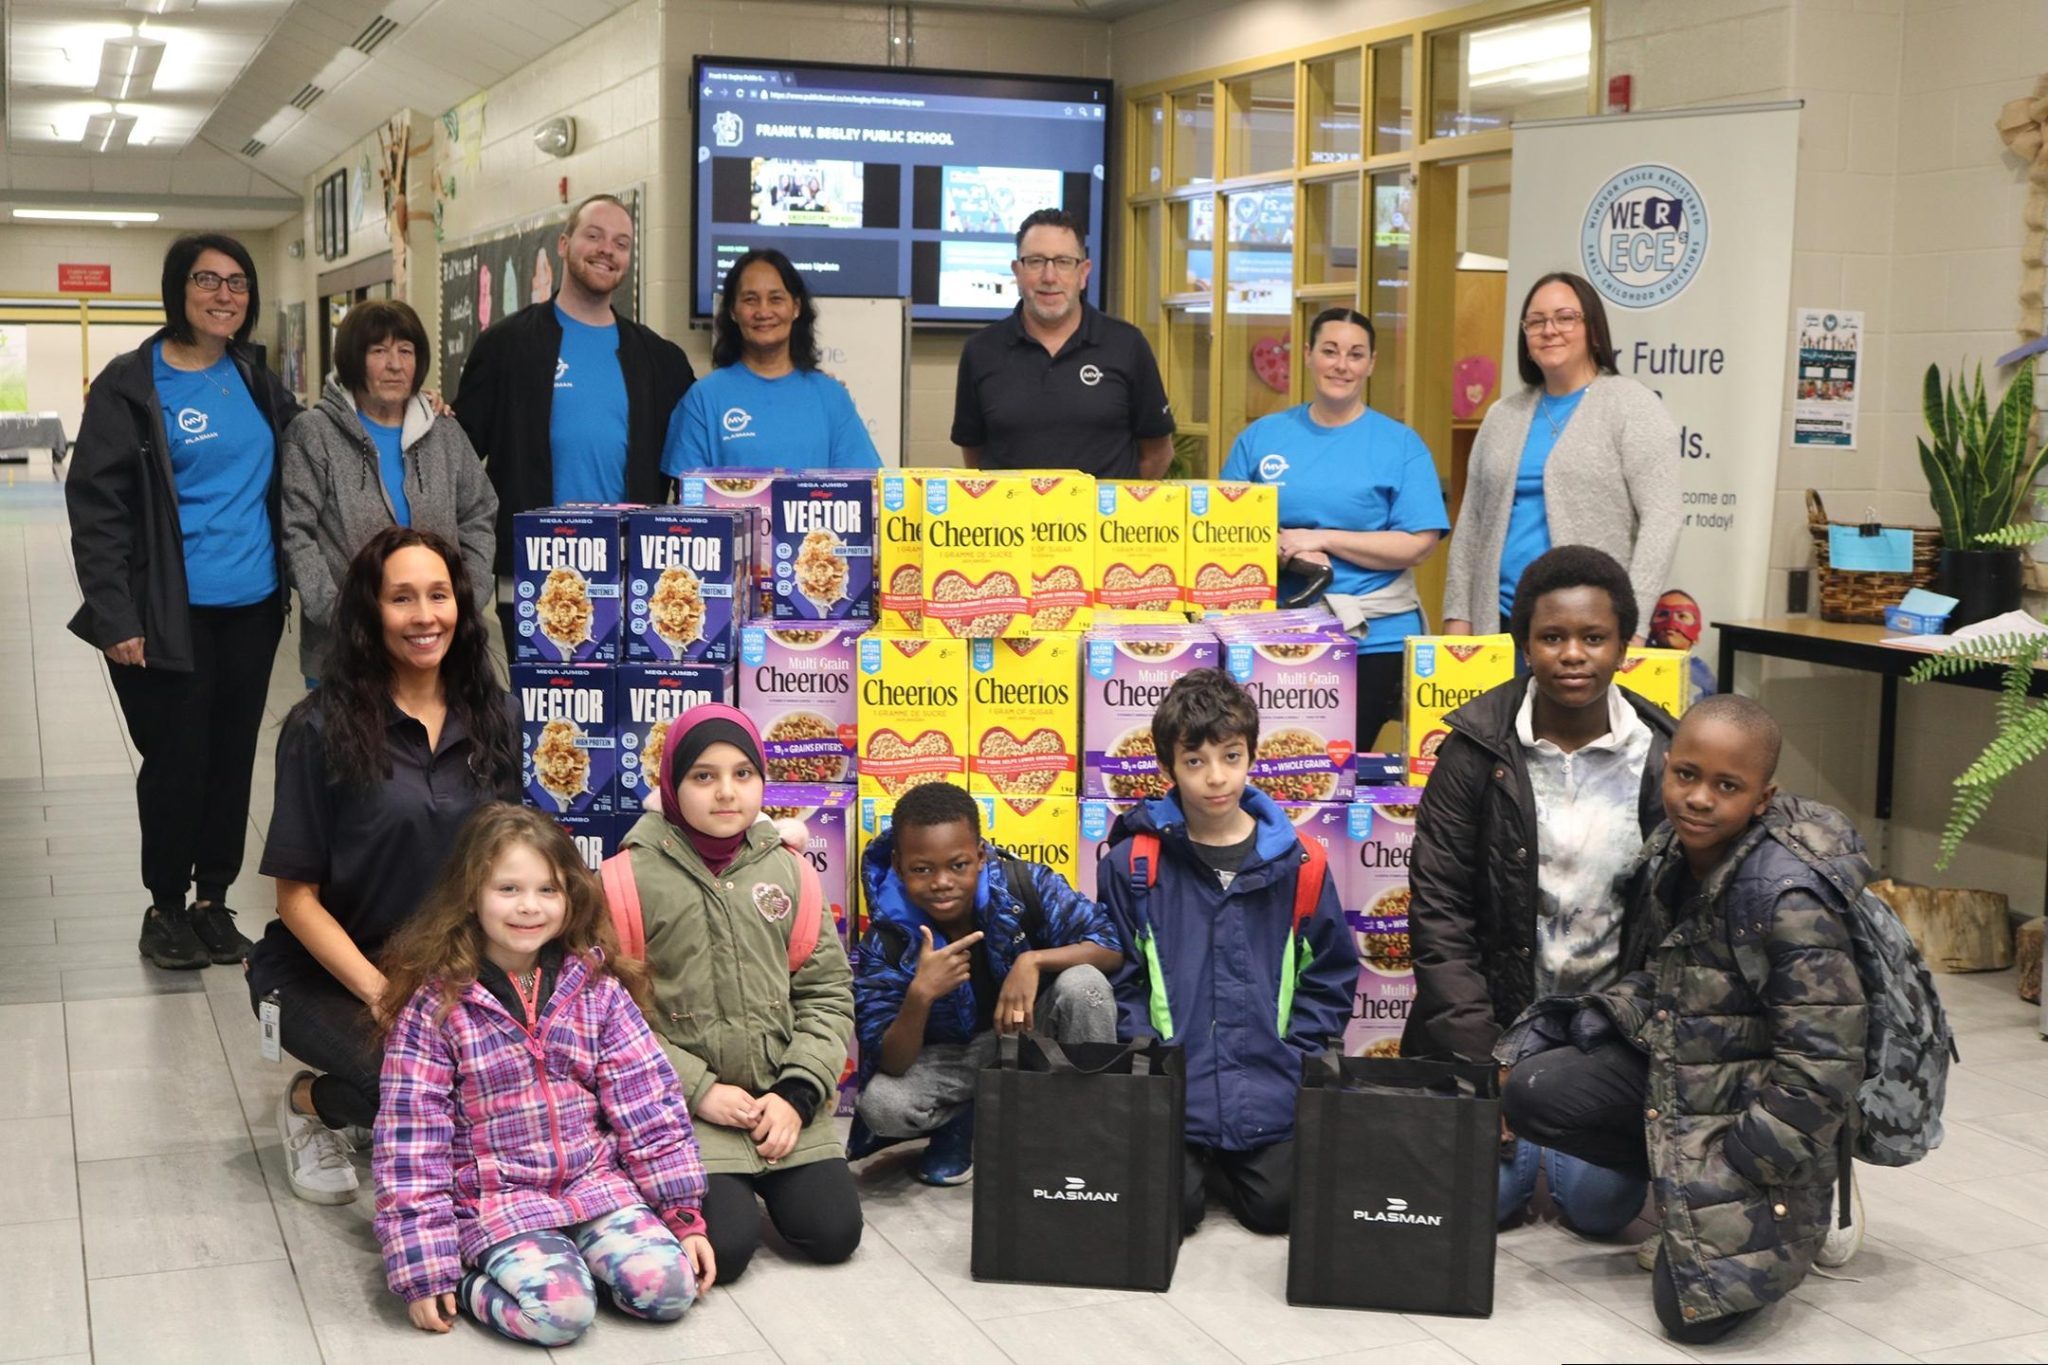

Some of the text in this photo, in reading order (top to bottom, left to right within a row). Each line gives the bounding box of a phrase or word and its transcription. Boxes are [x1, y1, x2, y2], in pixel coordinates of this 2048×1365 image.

[756, 124, 954, 146] FRANK W. BEGLEY PUBLIC SCHOOL
[1655, 202, 1671, 225] R
[1634, 342, 1724, 375] Future
[184, 432, 218, 445] PLASMAN
[722, 431, 756, 442] PLASMAN
[1682, 492, 1737, 506] come an
[783, 500, 862, 533] VECTOR
[1696, 514, 1734, 532] today!
[929, 520, 1024, 548] Cheerios
[1032, 522, 1088, 543] erios
[1100, 520, 1180, 544] Cheerios
[1192, 520, 1272, 544] Cheerios
[526, 536, 607, 572] VECTOR
[640, 535, 721, 572] VECTOR
[788, 658, 849, 670] Multi Grain
[755, 666, 850, 694] Cheerios
[1138, 670, 1168, 682] Multi
[1277, 672, 1340, 686] Multi Grain
[863, 679, 958, 706] Cheerios
[975, 678, 1069, 705] Cheerios
[1104, 679, 1168, 707] Cheer
[1416, 682, 1486, 708] Cheer
[522, 688, 604, 724] VECTOR
[589, 738, 612, 747] PROTEIN
[790, 744, 814, 754] GRAINS
[1278, 761, 1304, 771] WHOLE
[1304, 760, 1331, 769] GRAINS
[808, 836, 828, 848] ain
[992, 838, 1070, 865] heerios
[1360, 841, 1411, 868] Chee
[1381, 984, 1410, 996] Multi
[1033, 1188, 1118, 1202] PLASMAN
[1353, 1210, 1442, 1226] PLASMAN
